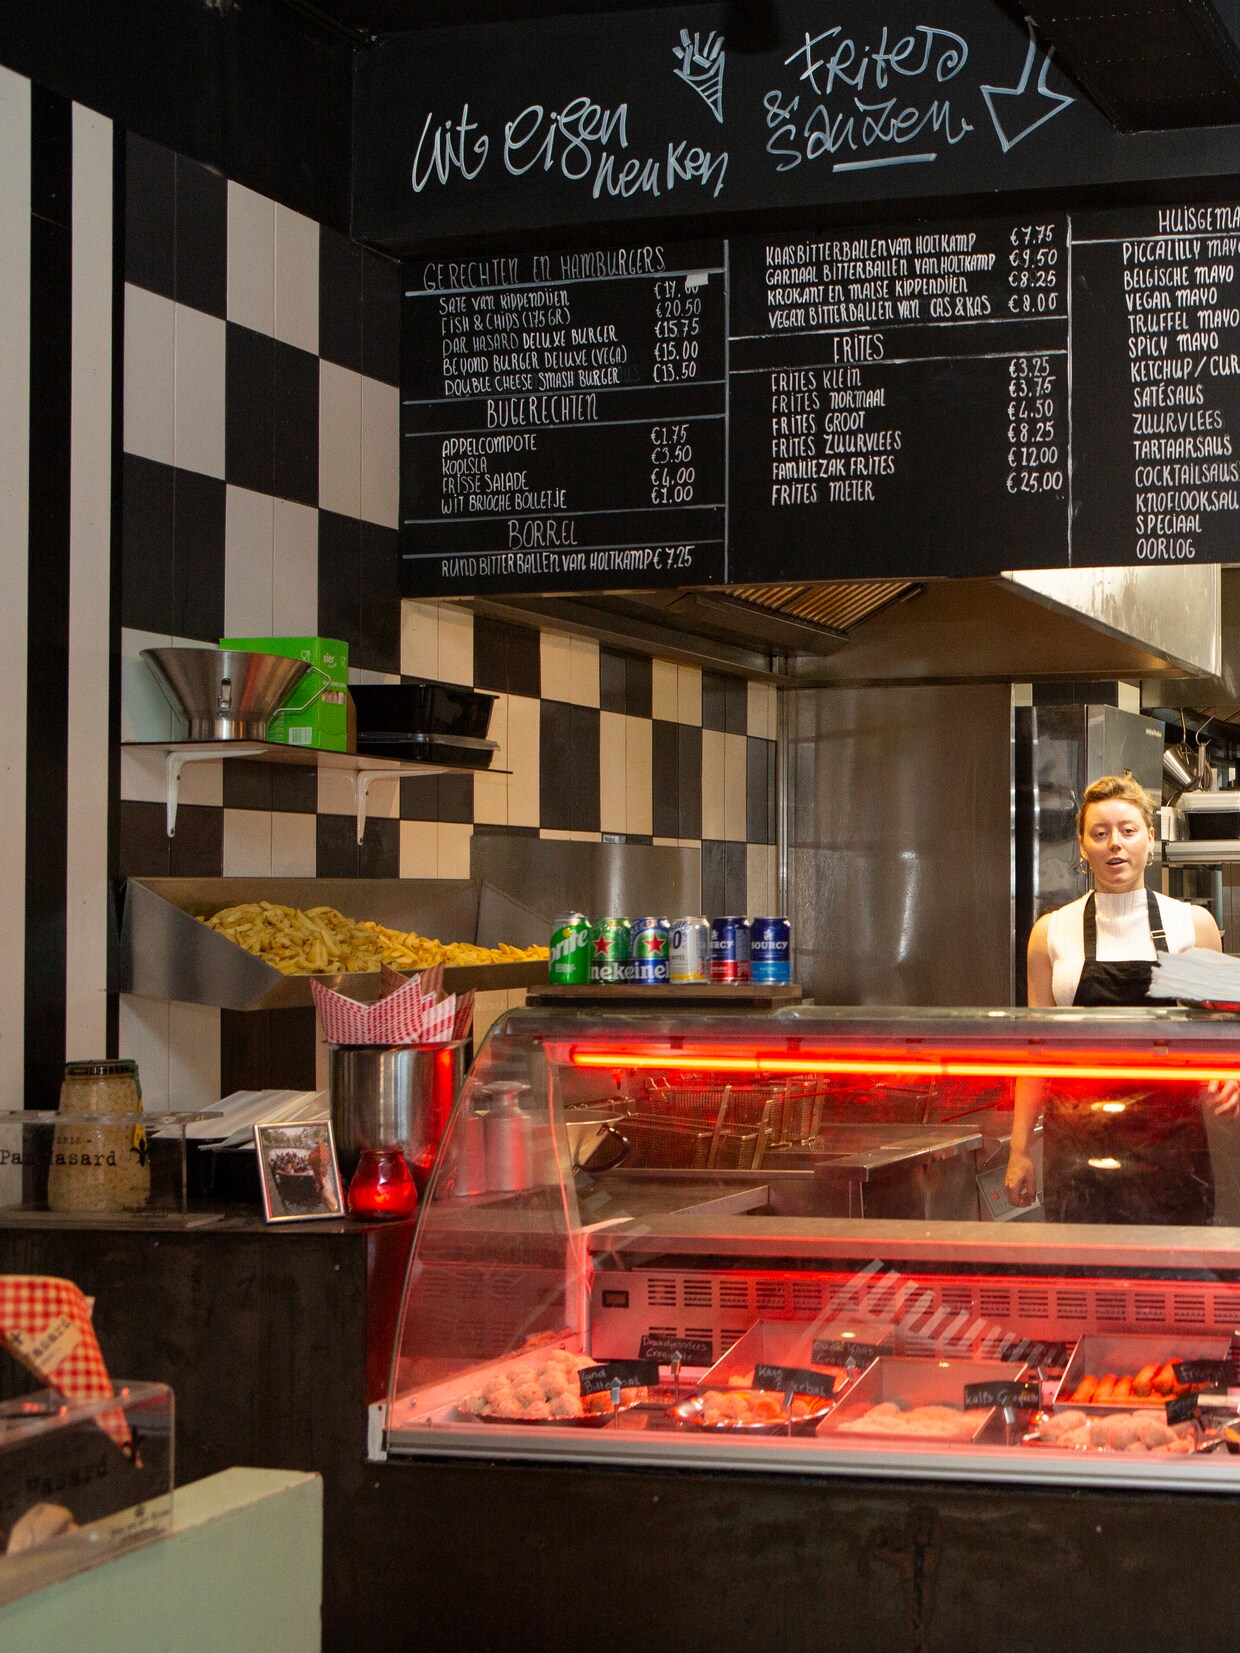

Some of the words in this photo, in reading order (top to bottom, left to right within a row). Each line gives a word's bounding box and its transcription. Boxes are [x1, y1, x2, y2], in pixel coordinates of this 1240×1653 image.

[504, 97, 629, 180] eigen
[916, 232, 976, 254] HOLTKAMP
[423, 258, 519, 291] GERECHTEN
[534, 256, 551, 280] EN
[560, 247, 666, 280] HAMBURGERS
[766, 266, 818, 285] GARNAAL
[823, 257, 908, 281] BITTERBALLEN
[914, 257, 939, 275] VAN
[940, 253, 996, 275] HOLTKAMP
[1124, 265, 1189, 291] BELGISCHE
[1194, 264, 1234, 284] MAYO
[768, 285, 825, 306] KROKANT
[829, 285, 845, 302] EN
[848, 280, 889, 300] MALSE
[1125, 291, 1171, 312] VEGAN
[1175, 286, 1217, 307] MAYO
[473, 314, 483, 330] &
[769, 308, 806, 329] VEGAN
[809, 300, 894, 325] BITTERBALLEN
[897, 299, 921, 319] VAN
[1128, 311, 1189, 334] TRUFFEL
[1197, 308, 1240, 329] MAYO
[523, 330, 565, 349] DELUXE
[571, 325, 618, 345] BURGER
[834, 333, 884, 363] FRITES
[1128, 335, 1167, 358] SPICY
[1176, 331, 1218, 352] MAYO
[443, 356, 488, 376] BEYOND
[493, 351, 540, 372] BURGER
[544, 349, 588, 369] DELUXE
[592, 345, 627, 366] (VEGA)
[445, 376, 492, 397] DOUBLE
[495, 374, 533, 391] CHEESE
[538, 371, 574, 391] SMASH
[578, 366, 621, 387] BURGER
[772, 371, 816, 392] FRITES
[823, 368, 861, 389] KLEIN
[772, 391, 820, 413] FRITES
[829, 388, 885, 409] NORMAAL
[772, 414, 816, 436] FRITES
[825, 410, 865, 432] GROOT
[1132, 410, 1222, 435] ZUURVLEES
[442, 434, 537, 457] APPELCOMPOTE
[772, 436, 815, 458] FRITES
[823, 430, 901, 454] ZUURVLEES
[1133, 434, 1232, 460] TARTAARSAUS
[773, 458, 846, 480] FAMILIEZAK
[850, 455, 895, 476] FRITES
[1135, 461, 1240, 488] COCKTAILSAUS
[485, 471, 529, 492] SALADE
[772, 482, 817, 506] FRITES
[829, 480, 875, 502] METER
[507, 520, 578, 550] BORREL
[1136, 513, 1202, 535] SPECIAAL
[590, 549, 653, 570] HOLTKAMP
[1136, 537, 1195, 559] OORLOG
